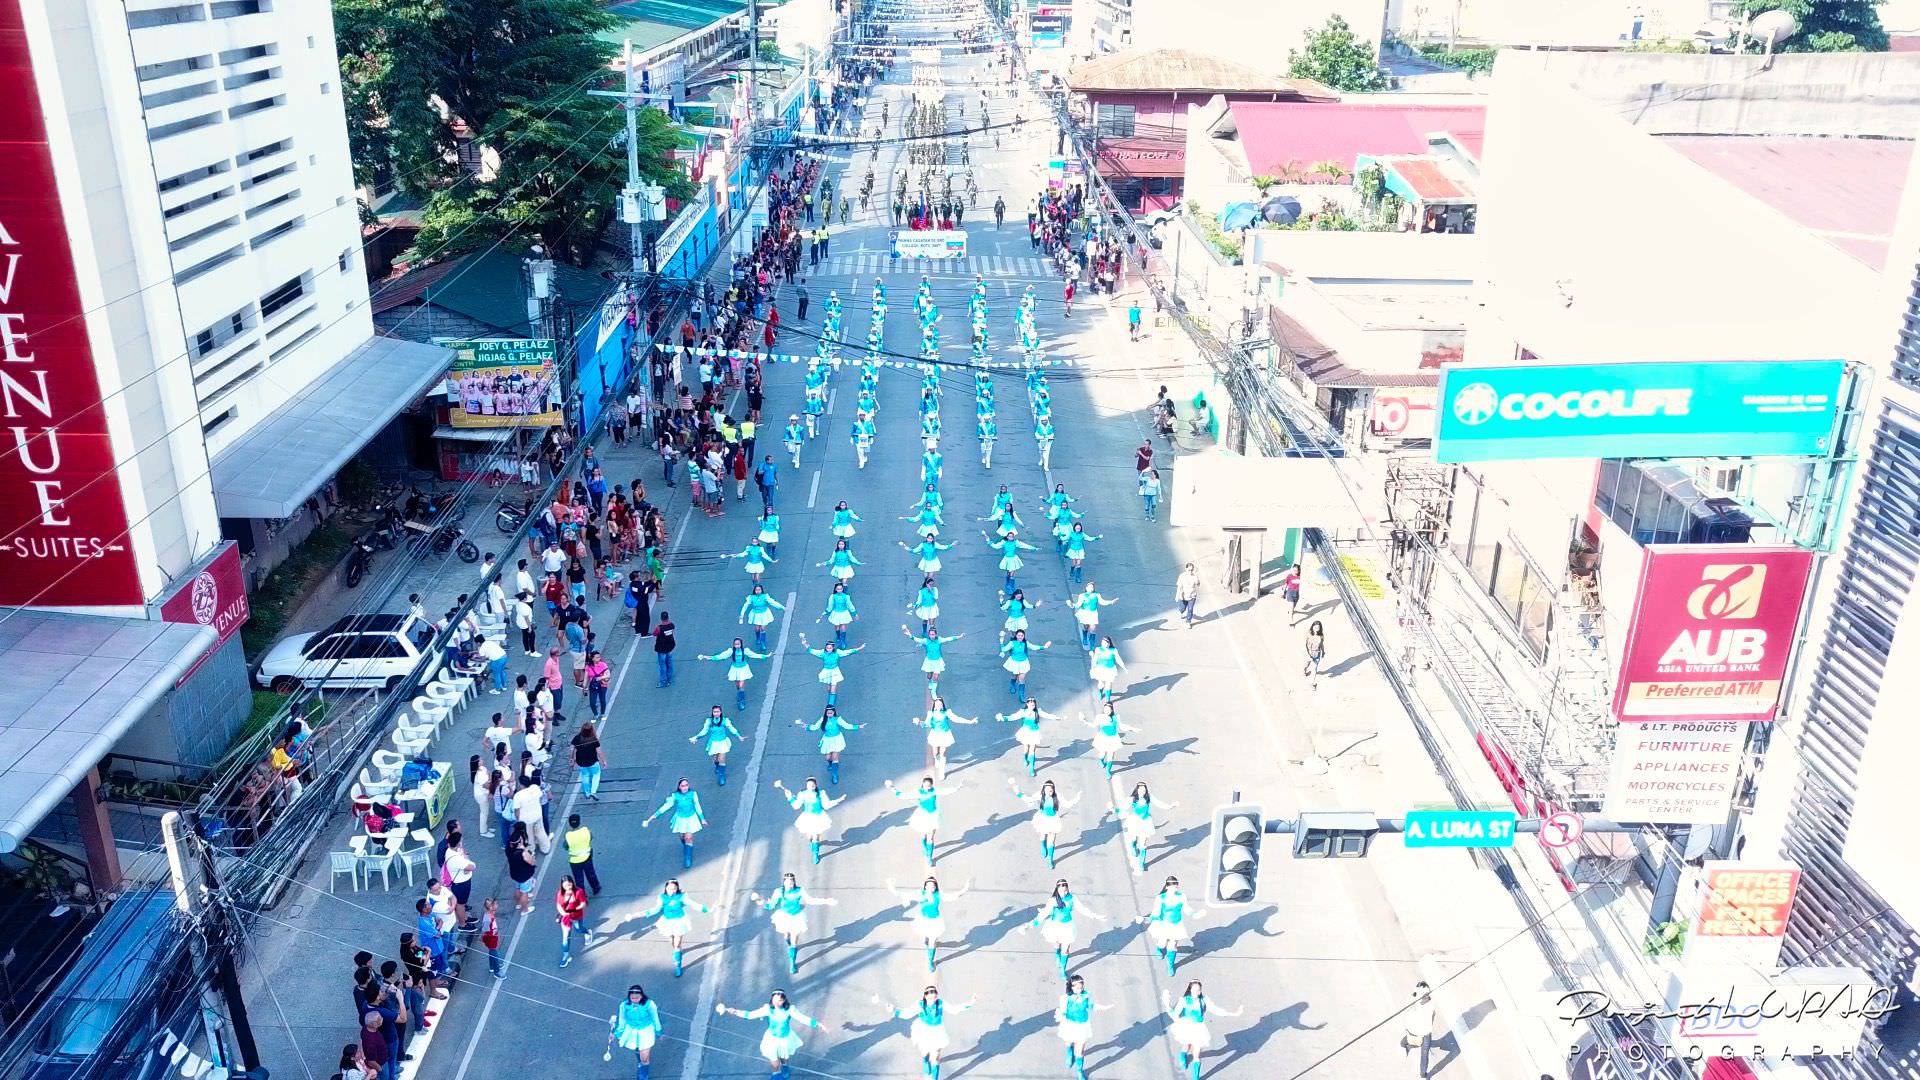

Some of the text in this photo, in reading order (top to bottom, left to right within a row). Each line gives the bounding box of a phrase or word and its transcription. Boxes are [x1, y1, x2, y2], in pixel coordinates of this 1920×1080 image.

[478, 341, 500, 351] JOEY
[502, 341, 511, 350] G.
[513, 340, 549, 349] PELAEZ
[478, 353, 506, 362] JIGJAG
[508, 352, 517, 361] G.
[519, 351, 554, 360] PELAEZ
[1499, 388, 1693, 421] COCOLIFE
[14, 536, 105, 558] SUITES
[1657, 628, 1767, 665] AUB
[1656, 663, 1760, 673] ASIA UNITED BANK
[1672, 724, 1737, 732] PRODUCTS
[1638, 741, 1732, 752] FURNITURE
[1633, 762, 1729, 773] APPLIANCES
[1628, 781, 1726, 791] MOTORCYCLES
[1674, 798, 1720, 806] SERVICE
[1430, 820, 1484, 839] LUNA
[1488, 820, 1512, 838] ST
[1715, 872, 1793, 888] OFFICE
[1710, 888, 1790, 905] SPACES
[1715, 906, 1777, 921] FOR
[1702, 920, 1782, 934] RENT
[1691, 1004, 1764, 1030] BDO
